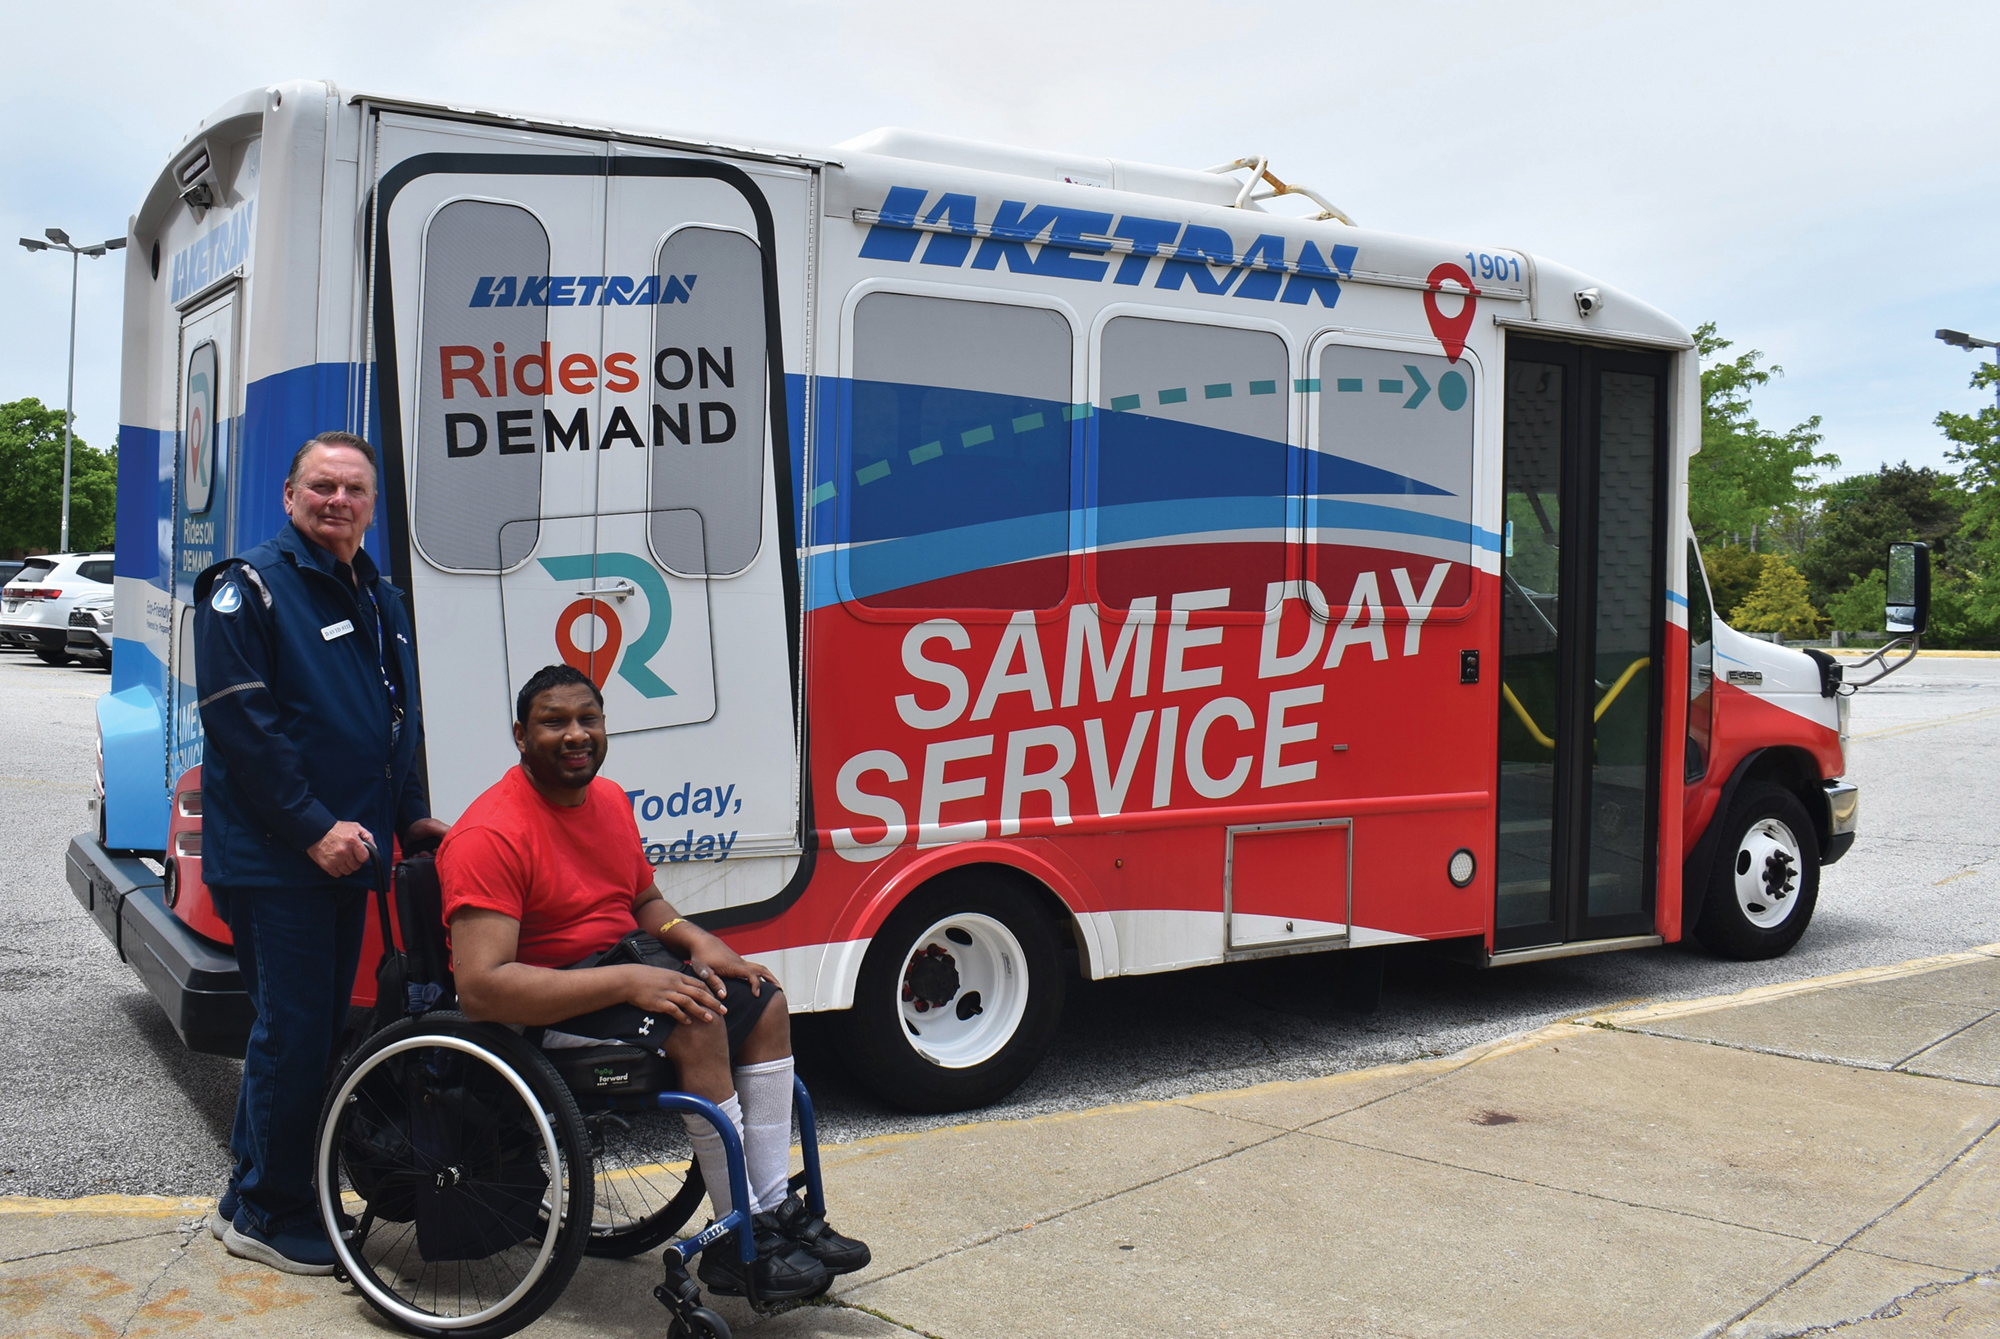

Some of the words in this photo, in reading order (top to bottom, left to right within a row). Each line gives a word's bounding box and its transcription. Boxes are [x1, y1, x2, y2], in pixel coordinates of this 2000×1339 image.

[171, 199, 254, 304] LAKETRAN
[858, 186, 1358, 308] LAKETRAN
[1465, 251, 1520, 283] 1901
[469, 275, 698, 308] LAKETRAN
[439, 341, 640, 400] Rides
[655, 346, 735, 390] ON
[445, 401, 737, 458] DEMAND
[183, 517, 204, 545] Rides
[204, 522, 215, 545] ON
[182, 549, 214, 572] DEMAND
[894, 588, 1230, 730] SAME
[1258, 562, 1452, 679] DAY
[1728, 670, 1763, 680] E-450
[829, 684, 1325, 863] SERVICE
[625, 782, 742, 821] Today,
